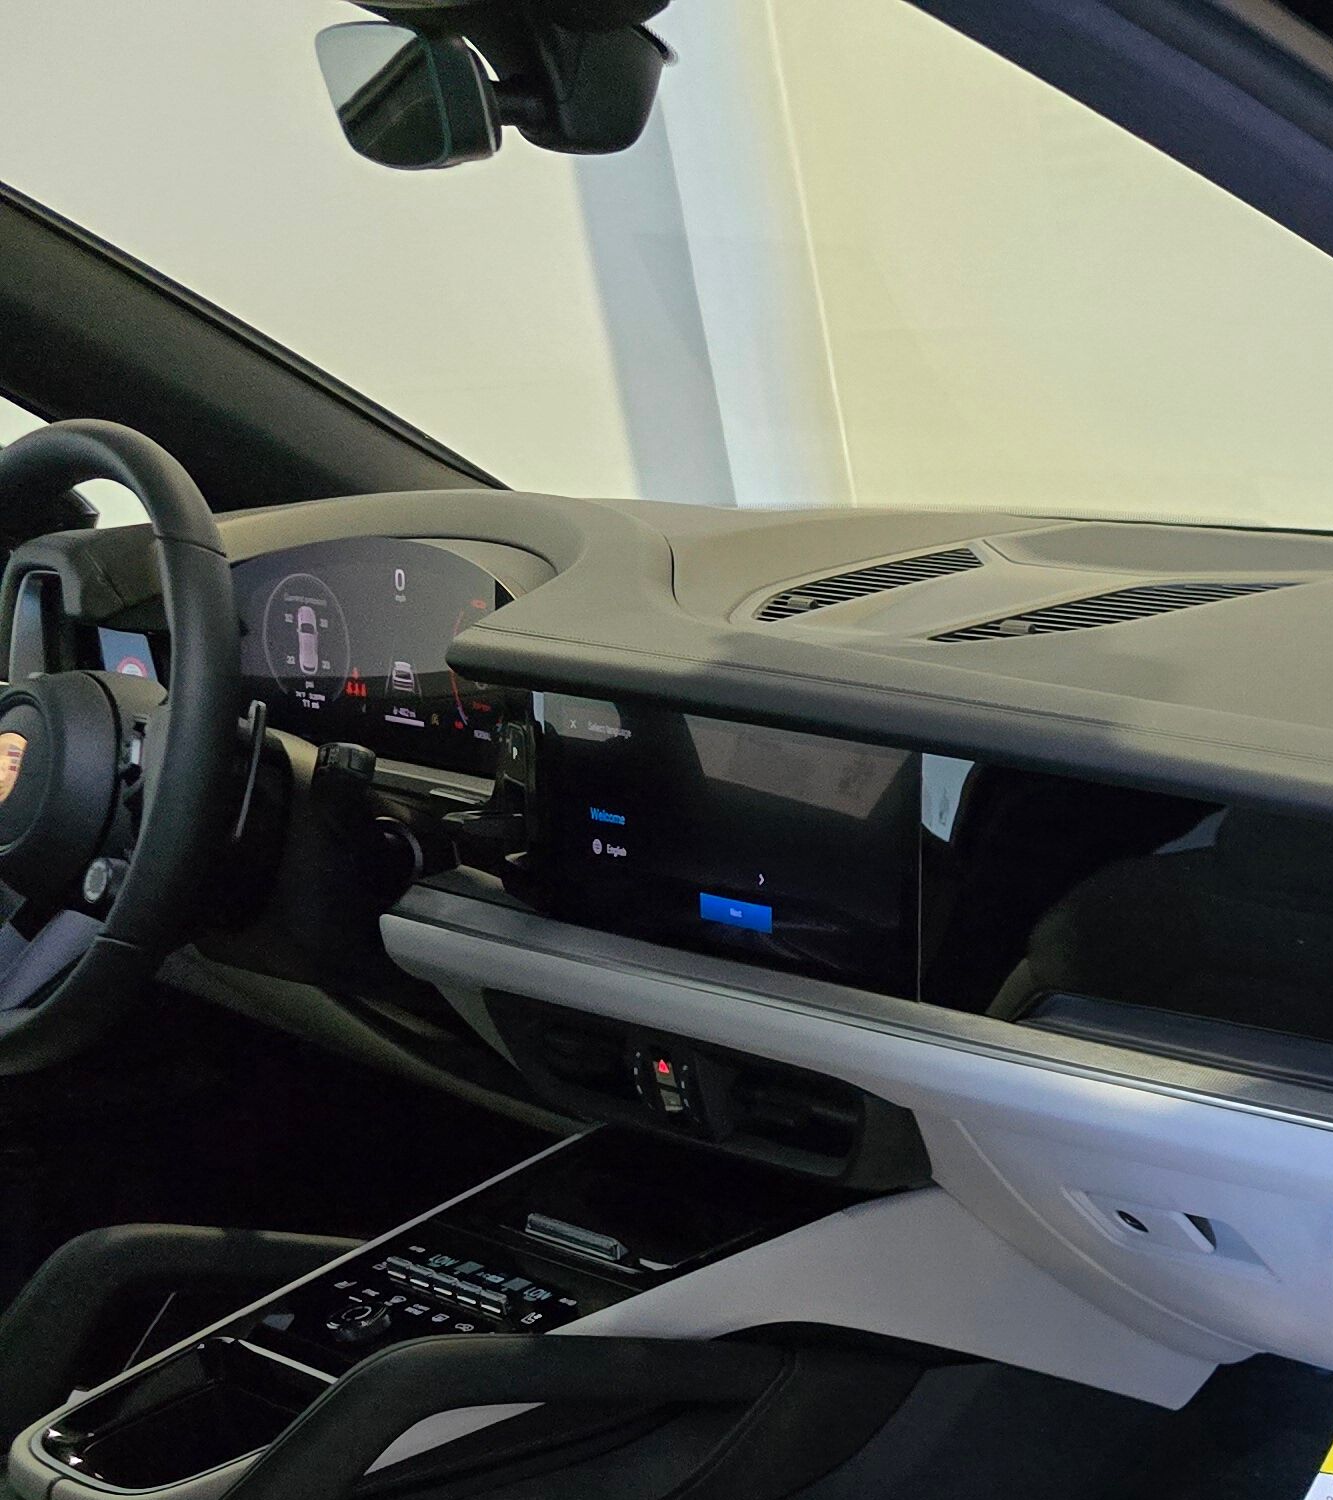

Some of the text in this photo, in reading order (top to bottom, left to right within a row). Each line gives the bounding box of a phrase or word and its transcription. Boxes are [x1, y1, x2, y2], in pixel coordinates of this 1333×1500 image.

[395, 568, 406, 592] 0
[590, 806, 626, 826] Welcome
[606, 843, 628, 858] English
